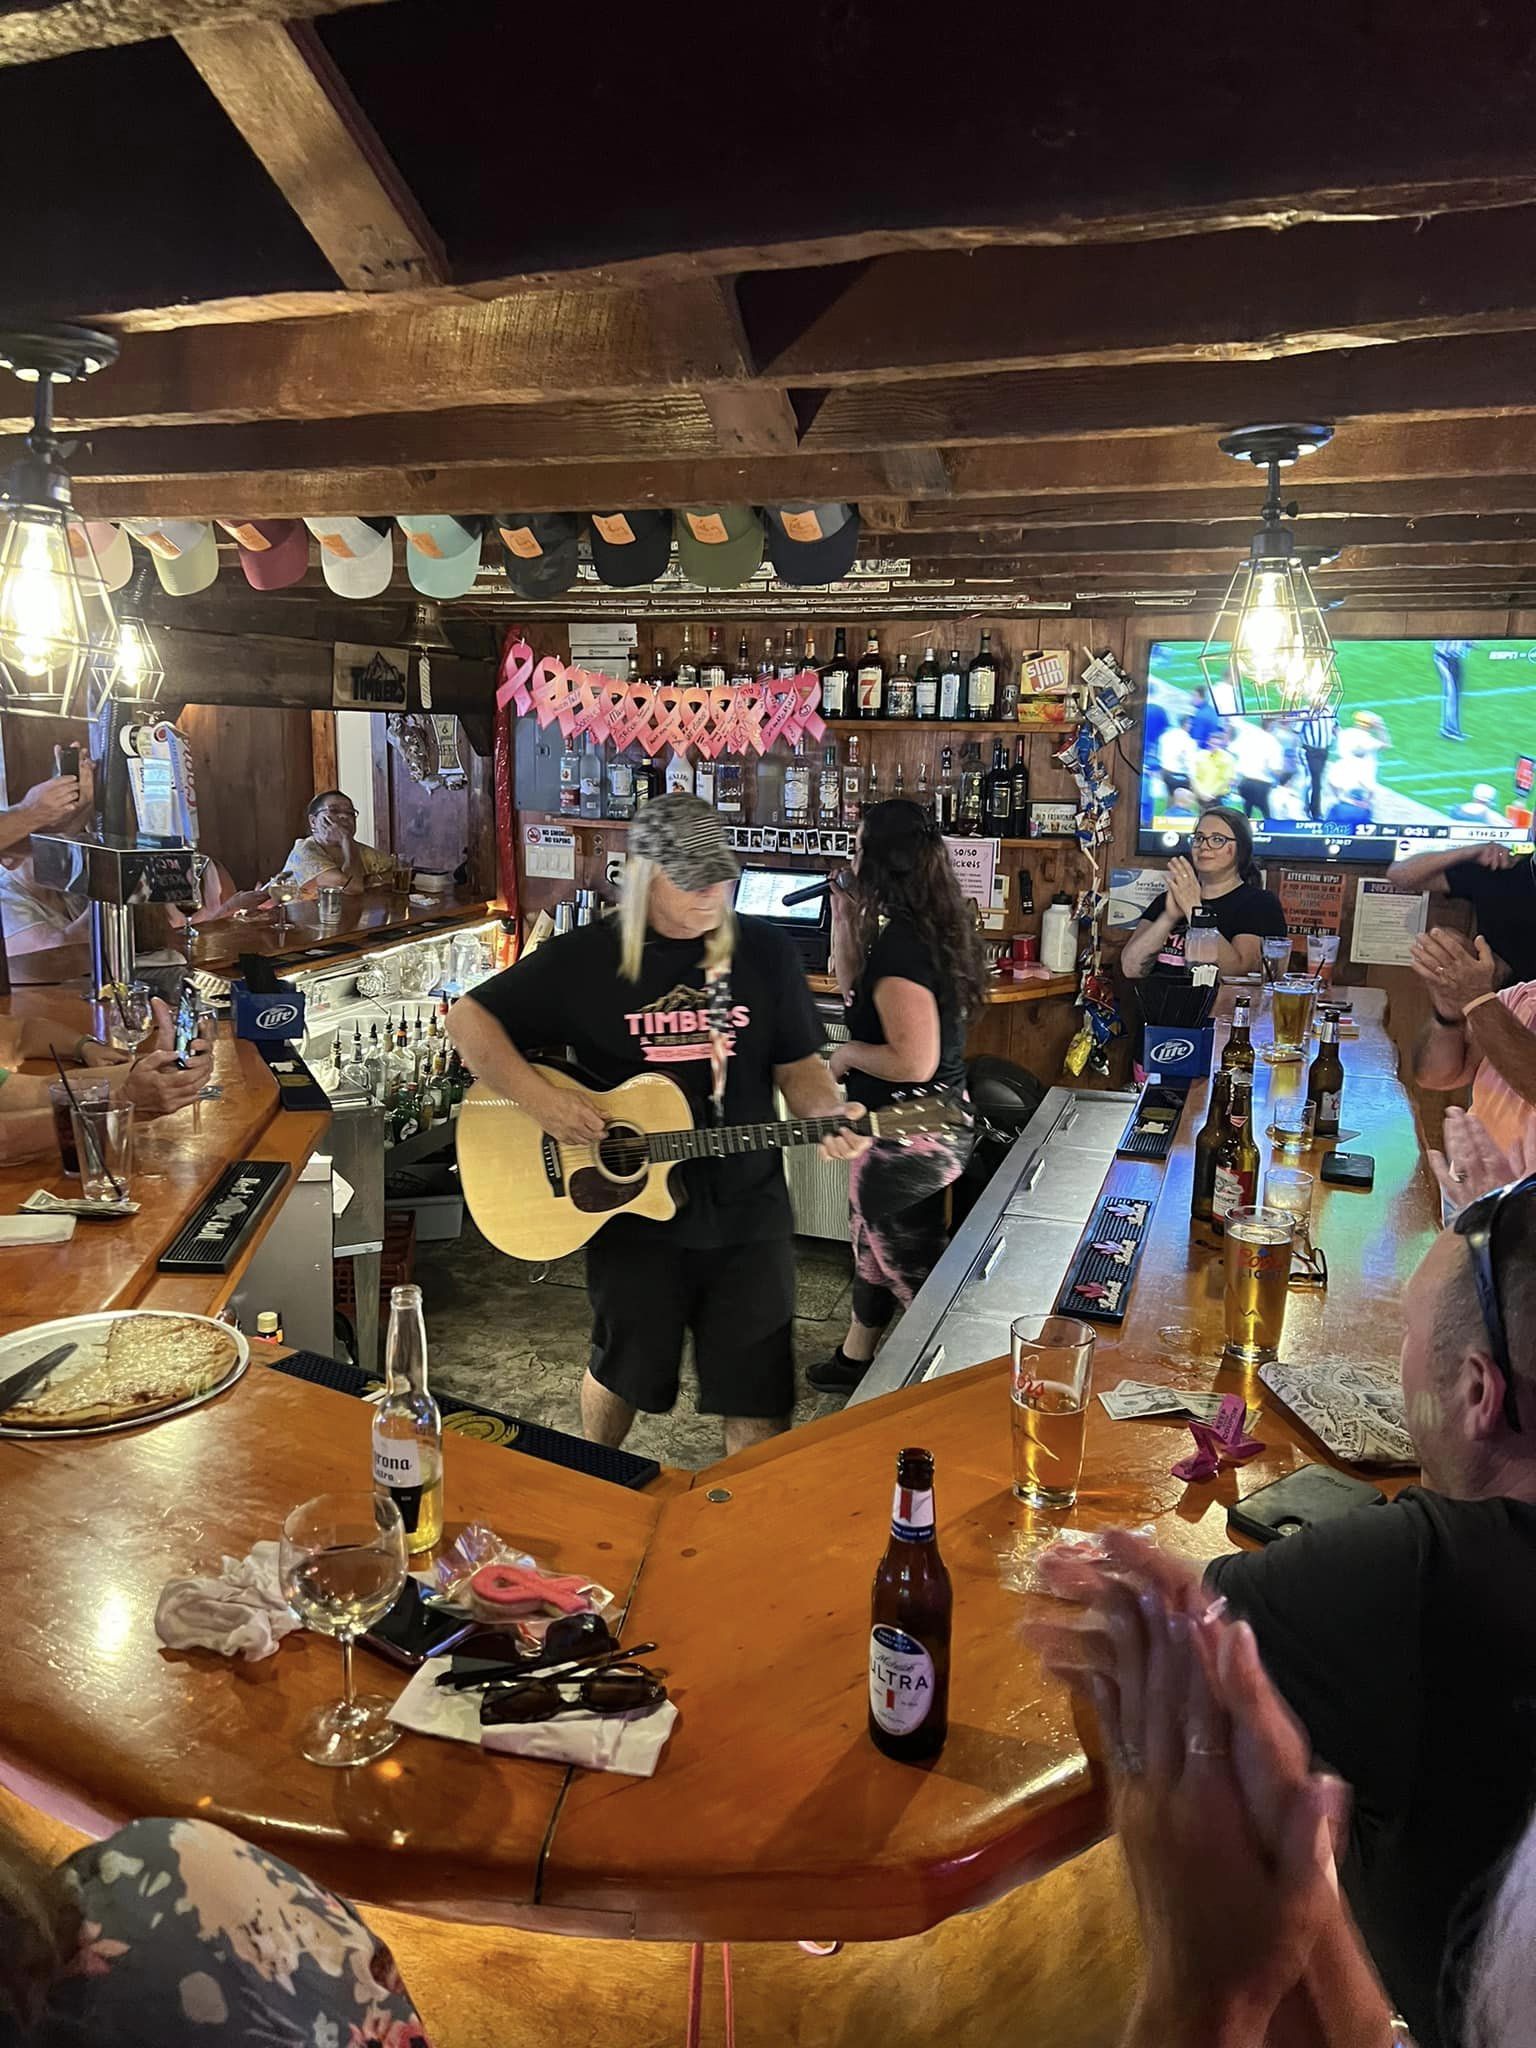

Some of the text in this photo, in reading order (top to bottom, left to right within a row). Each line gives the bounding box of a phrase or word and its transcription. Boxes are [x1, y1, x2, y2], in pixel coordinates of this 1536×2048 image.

[860, 679, 877, 706] 7
[1499, 830, 1510, 838] 17
[953, 848, 977, 857] 50/50
[952, 859, 980, 869] ickets
[263, 1010, 292, 1027] Lite
[623, 1005, 751, 1036] TIMBES
[1158, 1046, 1188, 1061] Lite
[1222, 1406, 1239, 1440] COUPON
